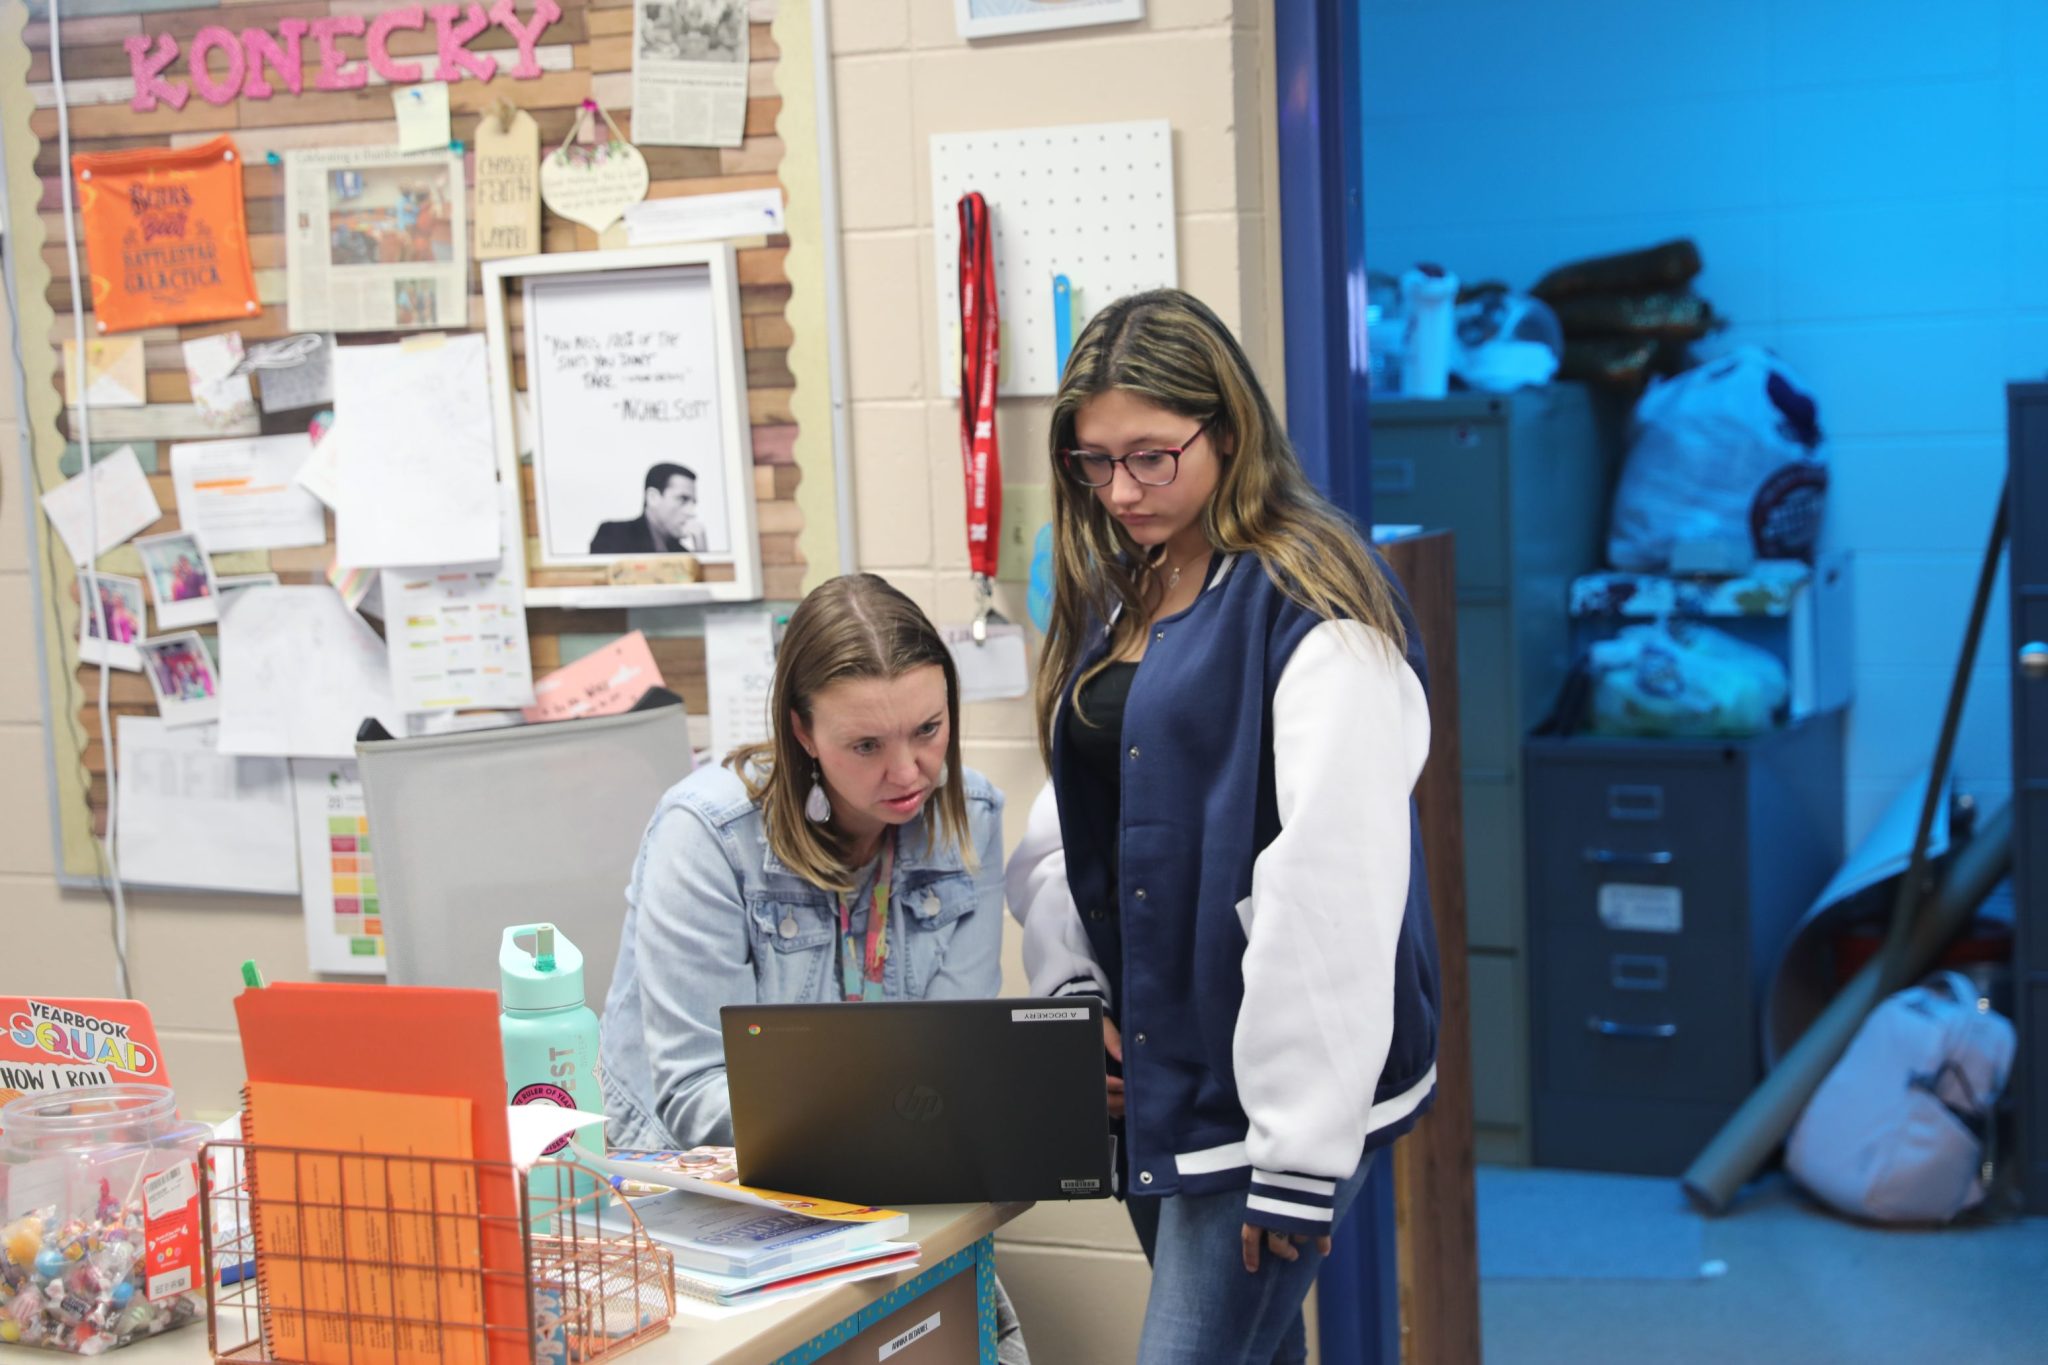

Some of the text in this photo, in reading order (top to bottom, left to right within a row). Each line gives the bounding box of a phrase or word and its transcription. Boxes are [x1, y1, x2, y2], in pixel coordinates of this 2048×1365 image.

[123, 0, 562, 112] KONECKY
[31, 1002, 127, 1039] YEARBOOK
[1024, 1012, 1068, 1020] DOCKERY
[12, 1014, 155, 1074] SQUAD
[0, 1067, 44, 1090] HOW
[52, 1070, 60, 1089] I
